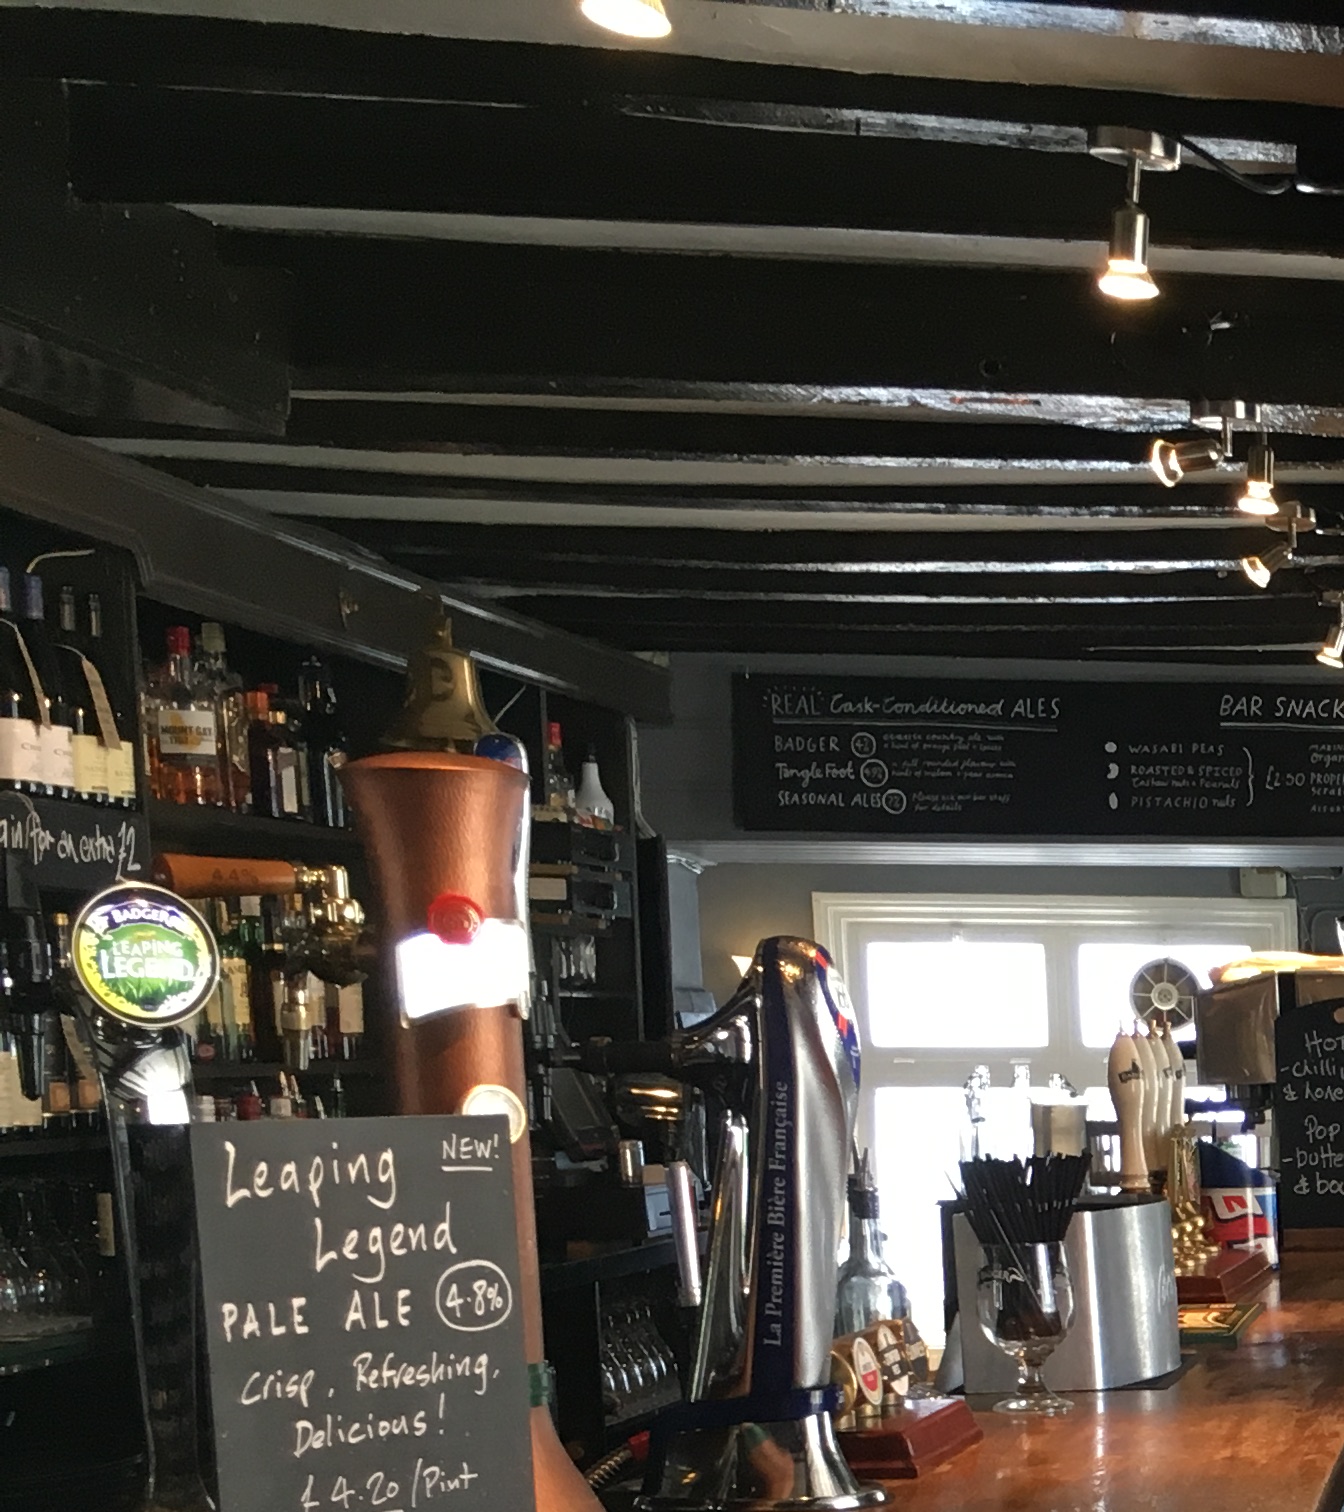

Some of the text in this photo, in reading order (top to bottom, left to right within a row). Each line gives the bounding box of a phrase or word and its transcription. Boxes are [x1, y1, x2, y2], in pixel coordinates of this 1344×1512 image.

[771, 693, 820, 716] REAL
[1010, 697, 1060, 719] ALES
[1220, 695, 1263, 718] BAR
[774, 735, 841, 753] BADGER
[1128, 742, 1225, 756] WASABI PEAS
[775, 762, 823, 788] Tangle
[824, 762, 856, 780] Foot
[777, 791, 881, 808] SEASONAL ALES
[112, 939, 184, 957] LEAPING
[100, 949, 195, 981] LEGED
[224, 1133, 500, 1210] Leaping NEW!
[763, 1081, 794, 1347] La Première Bière Française
[313, 1201, 459, 1284] Legend
[221, 1278, 504, 1343] PALE ALE 4.8%
[293, 1391, 447, 1459] Delicious!
